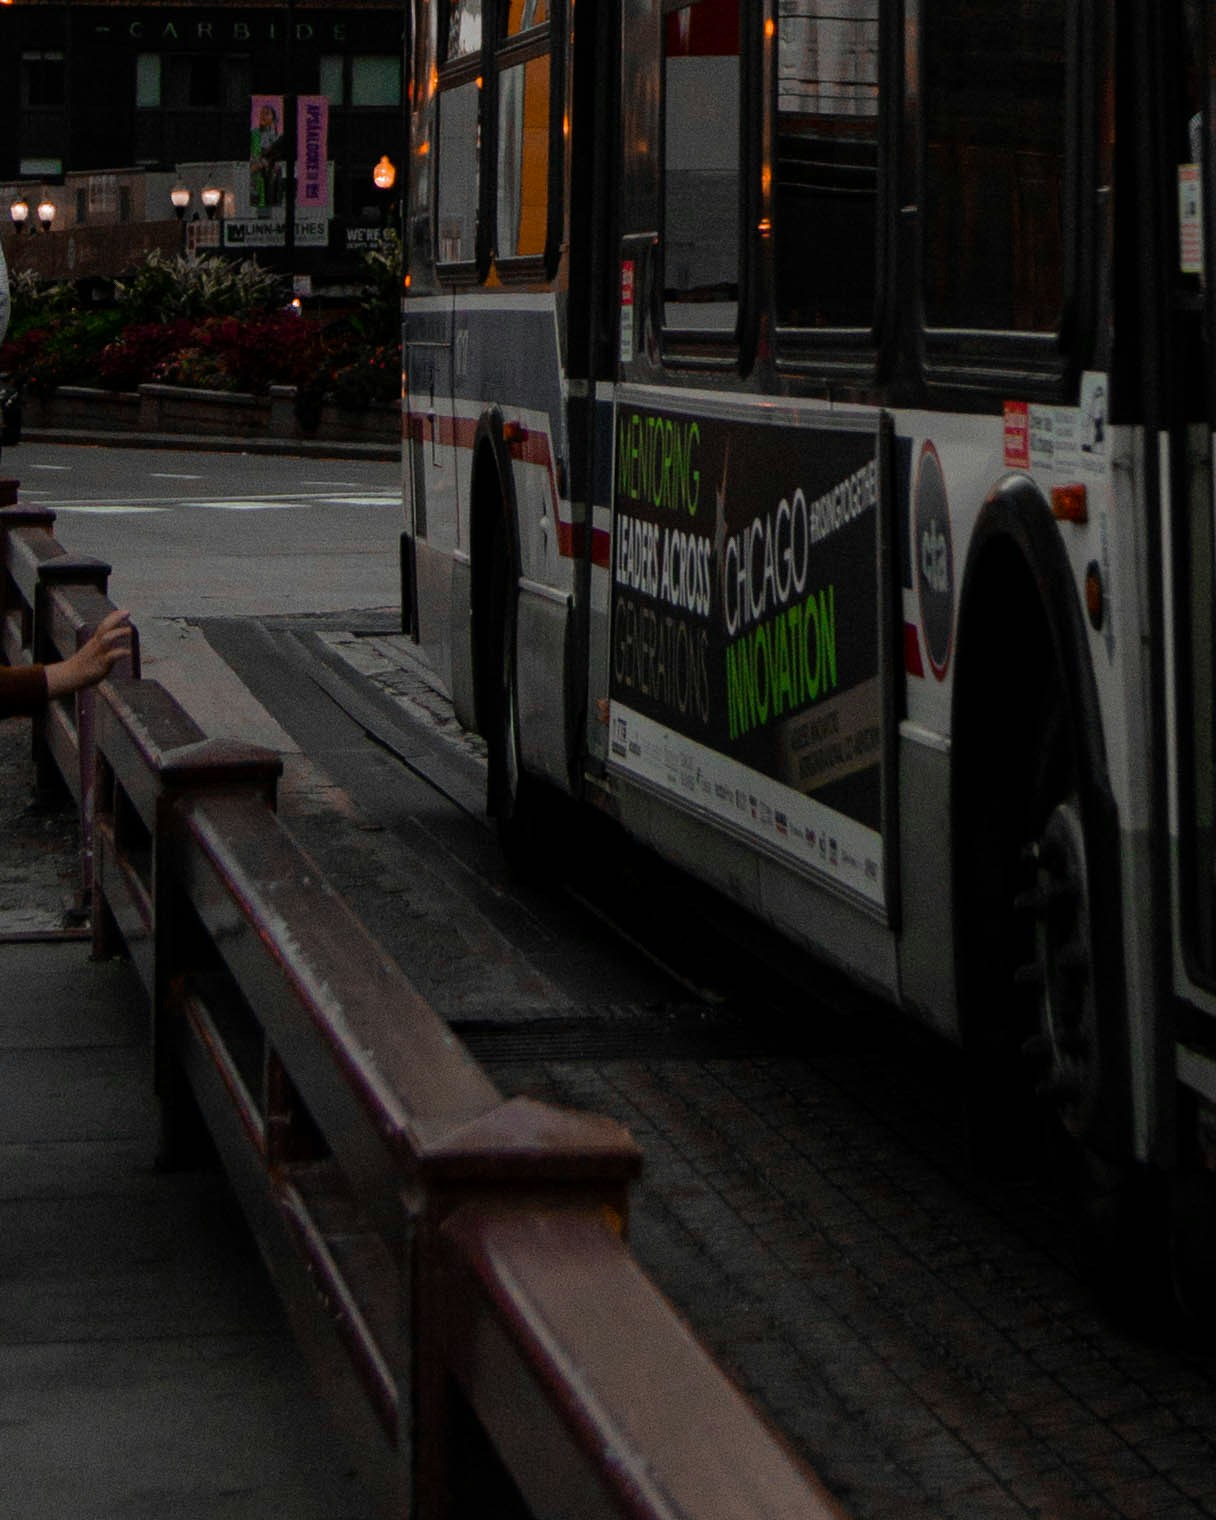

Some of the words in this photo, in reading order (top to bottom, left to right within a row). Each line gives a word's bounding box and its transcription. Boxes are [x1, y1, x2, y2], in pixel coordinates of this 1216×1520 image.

[127, 21, 348, 41] CARBIDE
[618, 412, 701, 518] MENTORING
[616, 511, 660, 599] LEADERS
[660, 527, 712, 618] ACROSS
[724, 487, 809, 637] CHICAGO
[614, 595, 711, 726] GENERATIONS
[726, 583, 839, 744] INNOVATION
